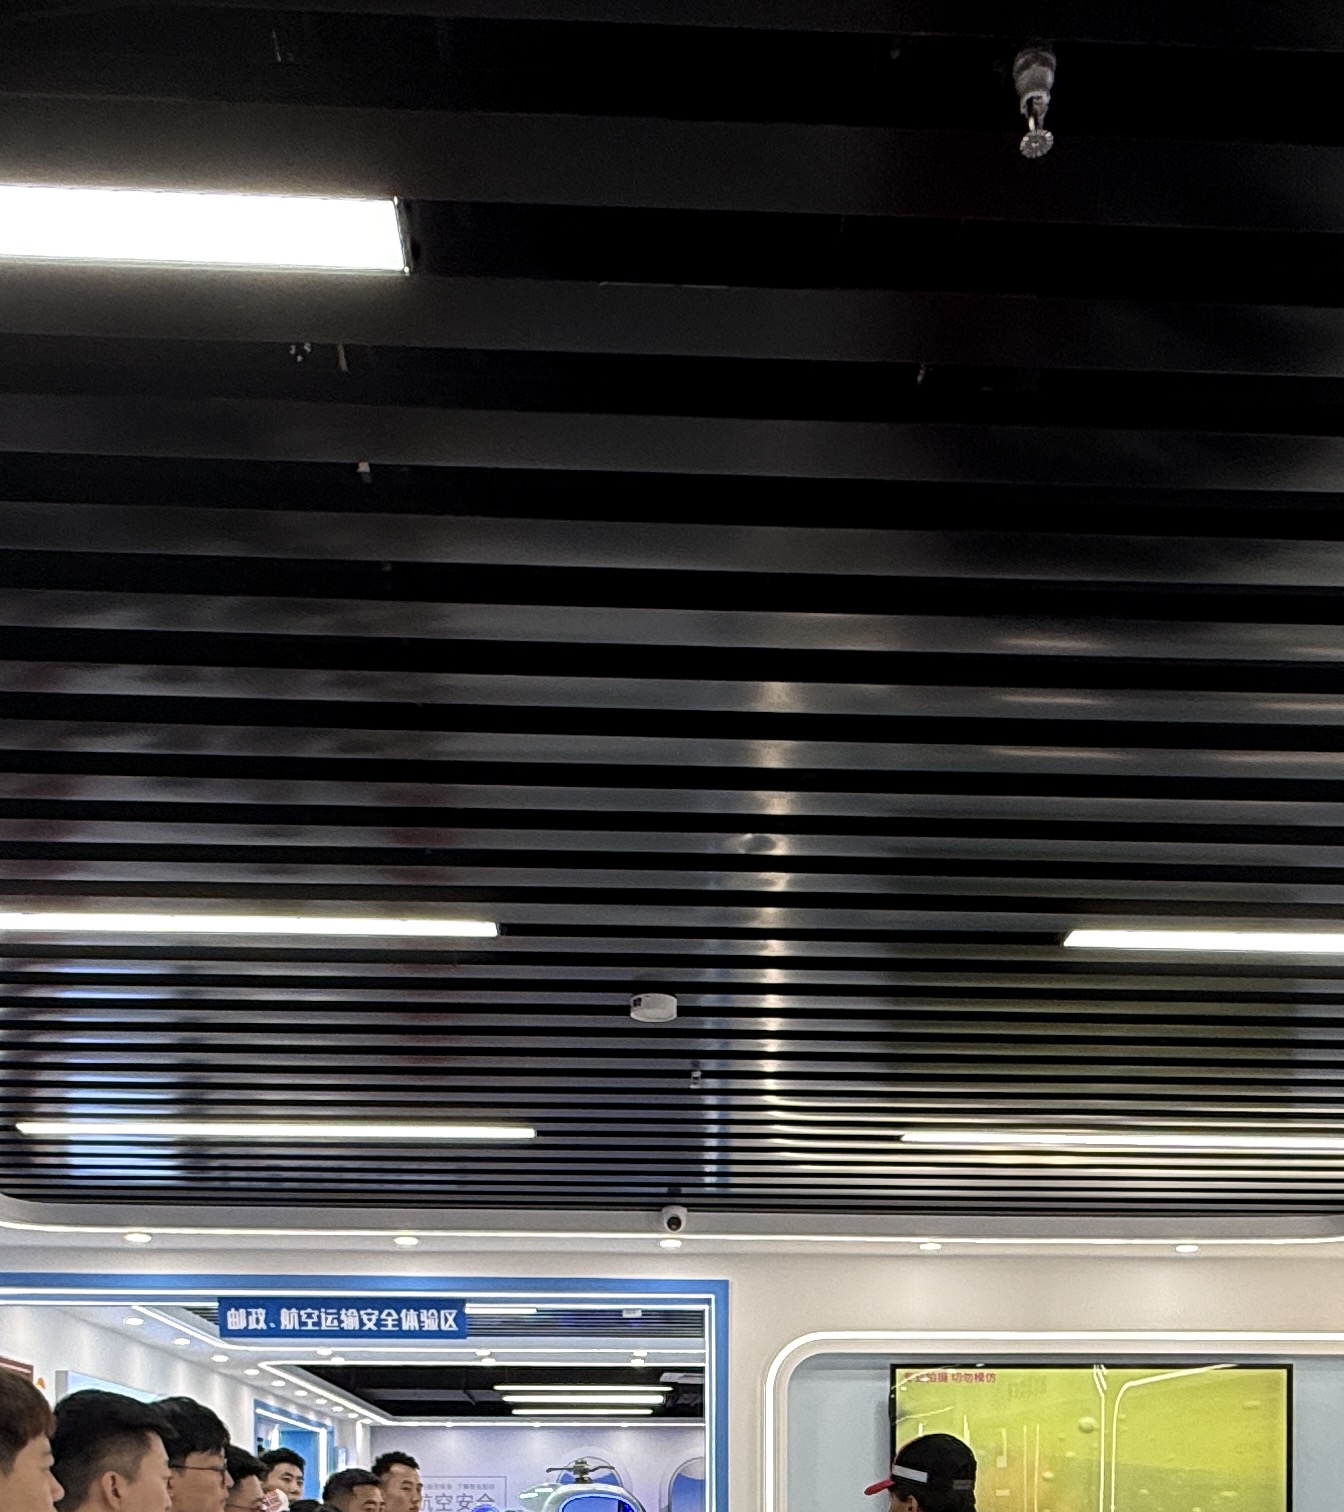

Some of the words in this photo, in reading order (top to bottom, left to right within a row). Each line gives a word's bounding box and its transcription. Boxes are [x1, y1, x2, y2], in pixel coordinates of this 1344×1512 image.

[226, 1308, 460, 1331] 邮政、航空运输安全体验区
